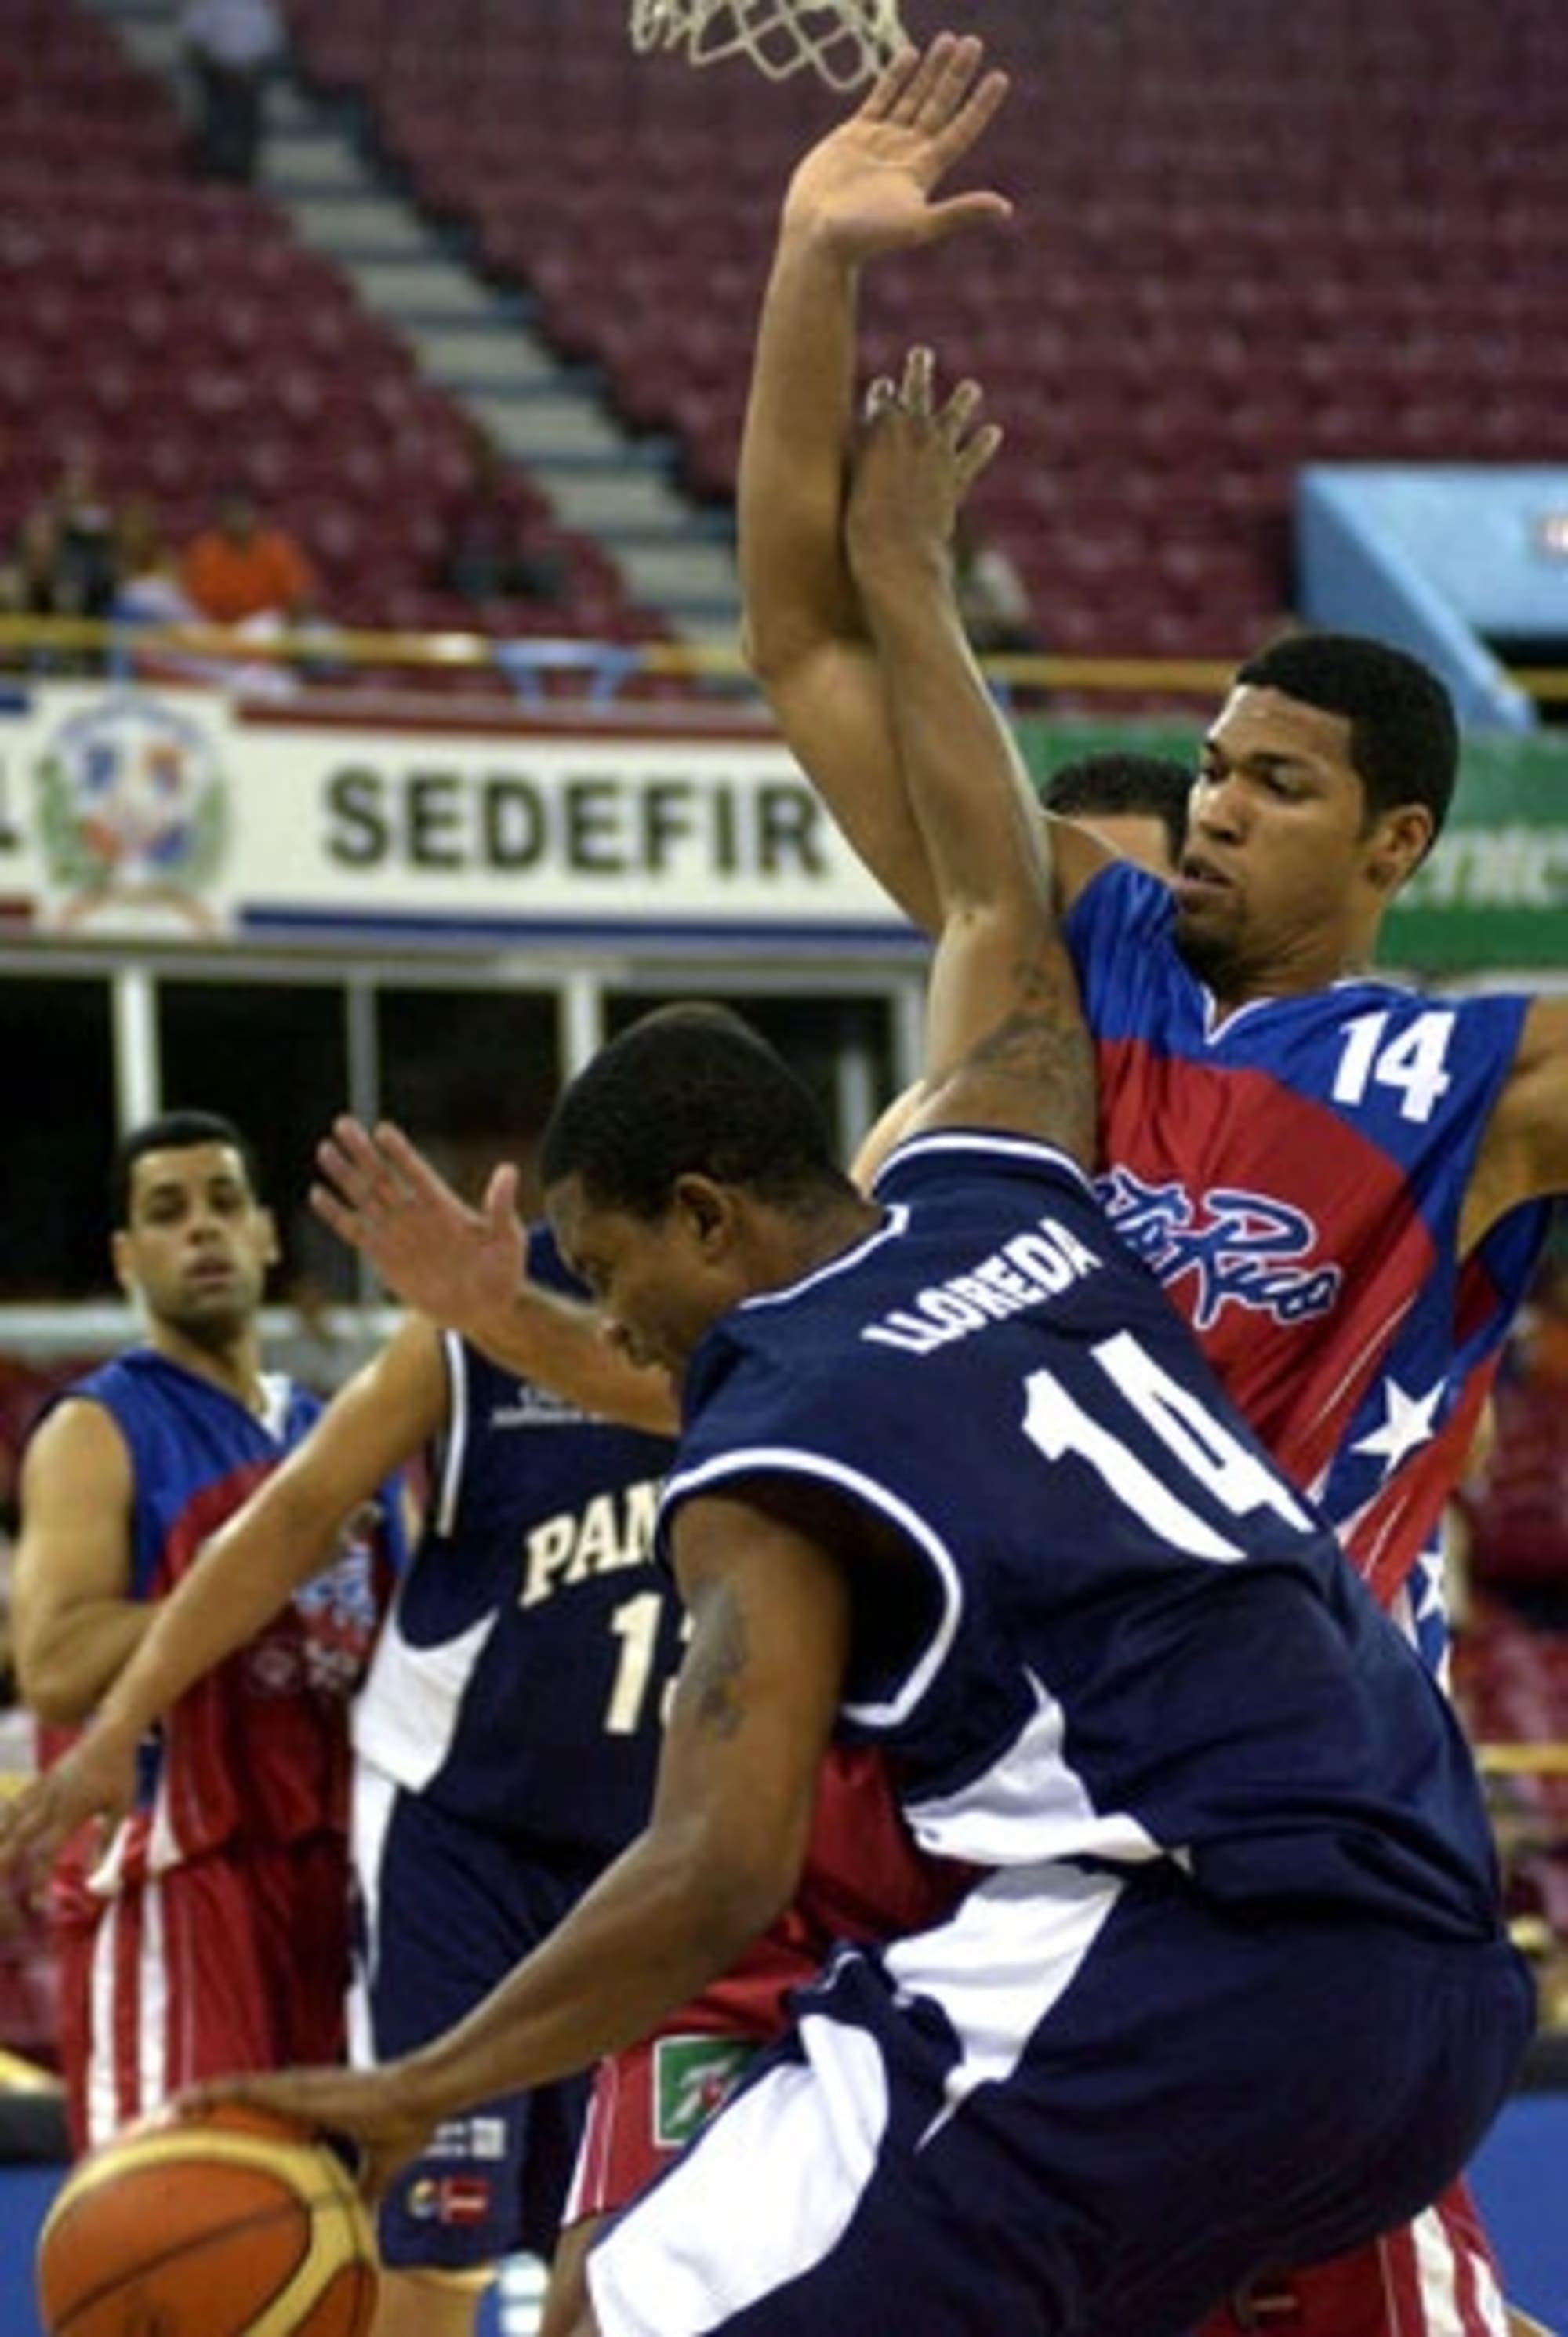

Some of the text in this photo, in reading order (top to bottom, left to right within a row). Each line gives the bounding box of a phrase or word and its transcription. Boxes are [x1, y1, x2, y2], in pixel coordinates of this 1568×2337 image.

[324, 764, 826, 880] SEDEFIR
[1332, 1010, 1456, 1123] 14
[861, 1217, 1102, 1354] LLOREDA
[1021, 1328, 1317, 1564] 14
